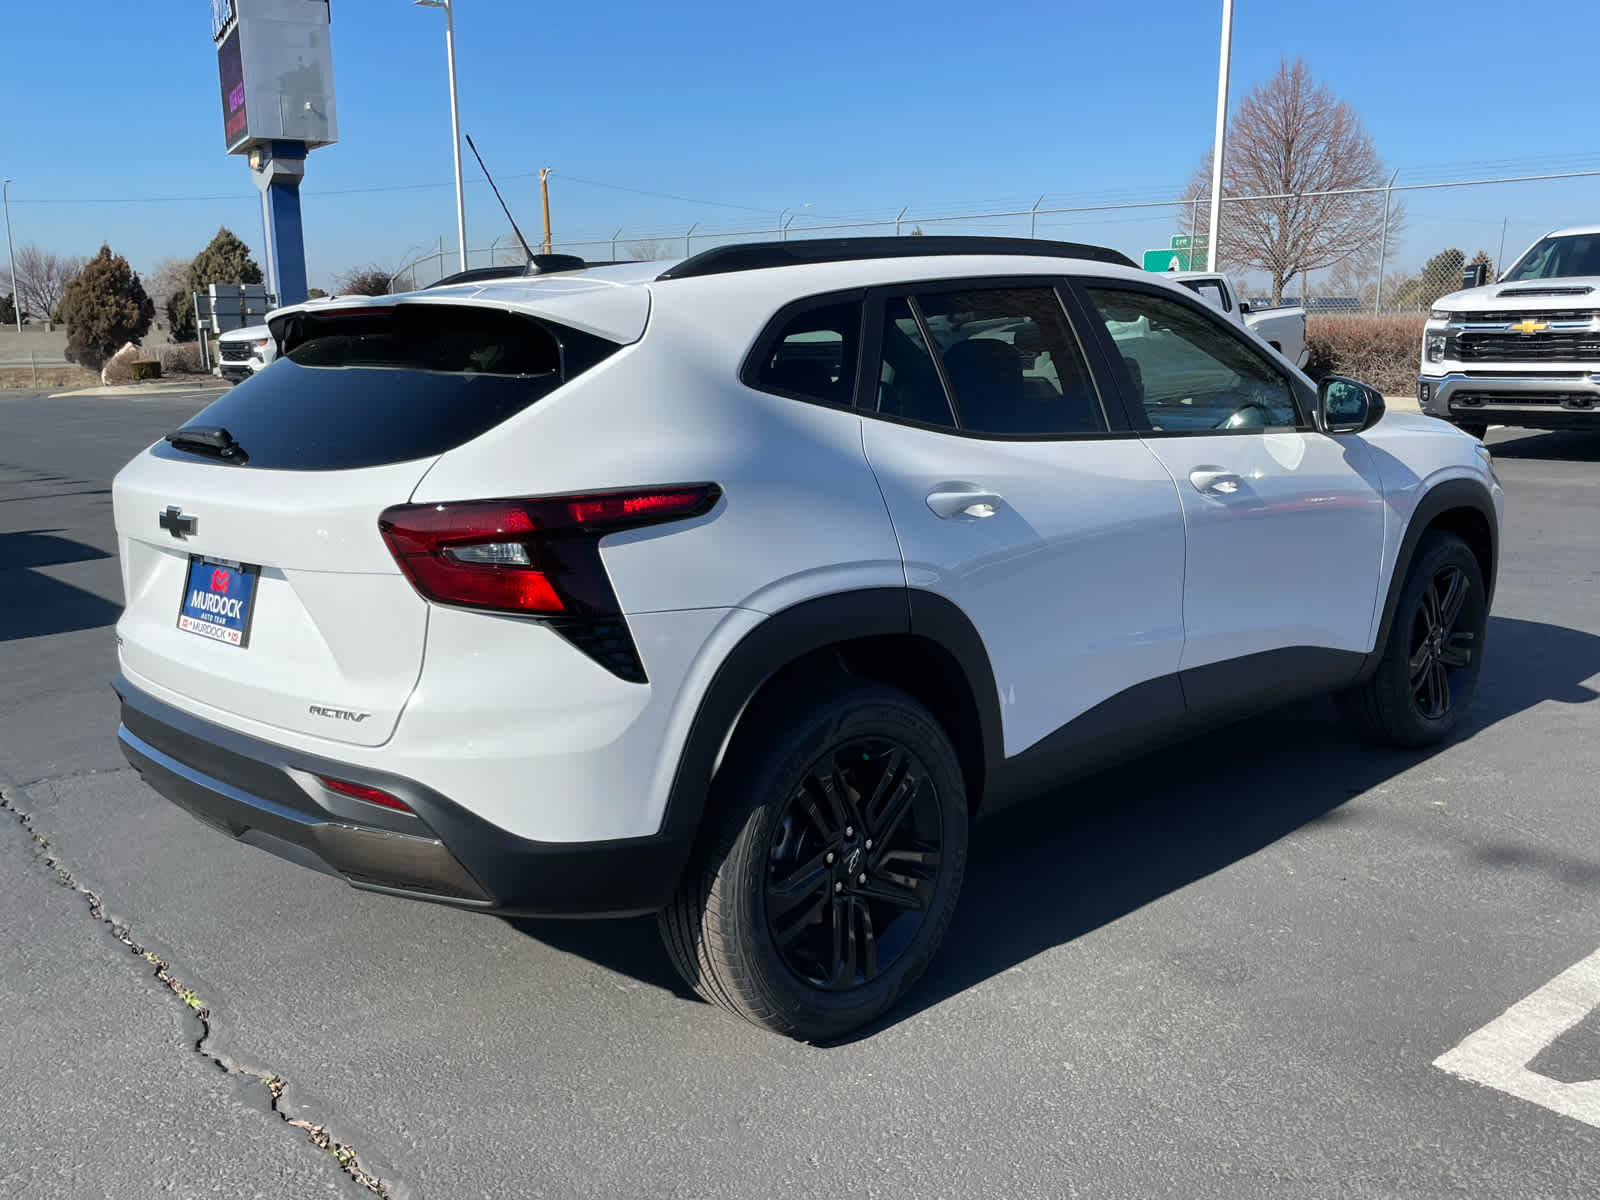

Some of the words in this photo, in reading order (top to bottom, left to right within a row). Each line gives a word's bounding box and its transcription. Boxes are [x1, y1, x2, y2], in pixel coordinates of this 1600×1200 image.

[191, 589, 243, 619] MURDOCK
[200, 612, 213, 621] AUTO
[192, 620, 225, 639] MURDOCK
[309, 705, 371, 722] ACTIV
